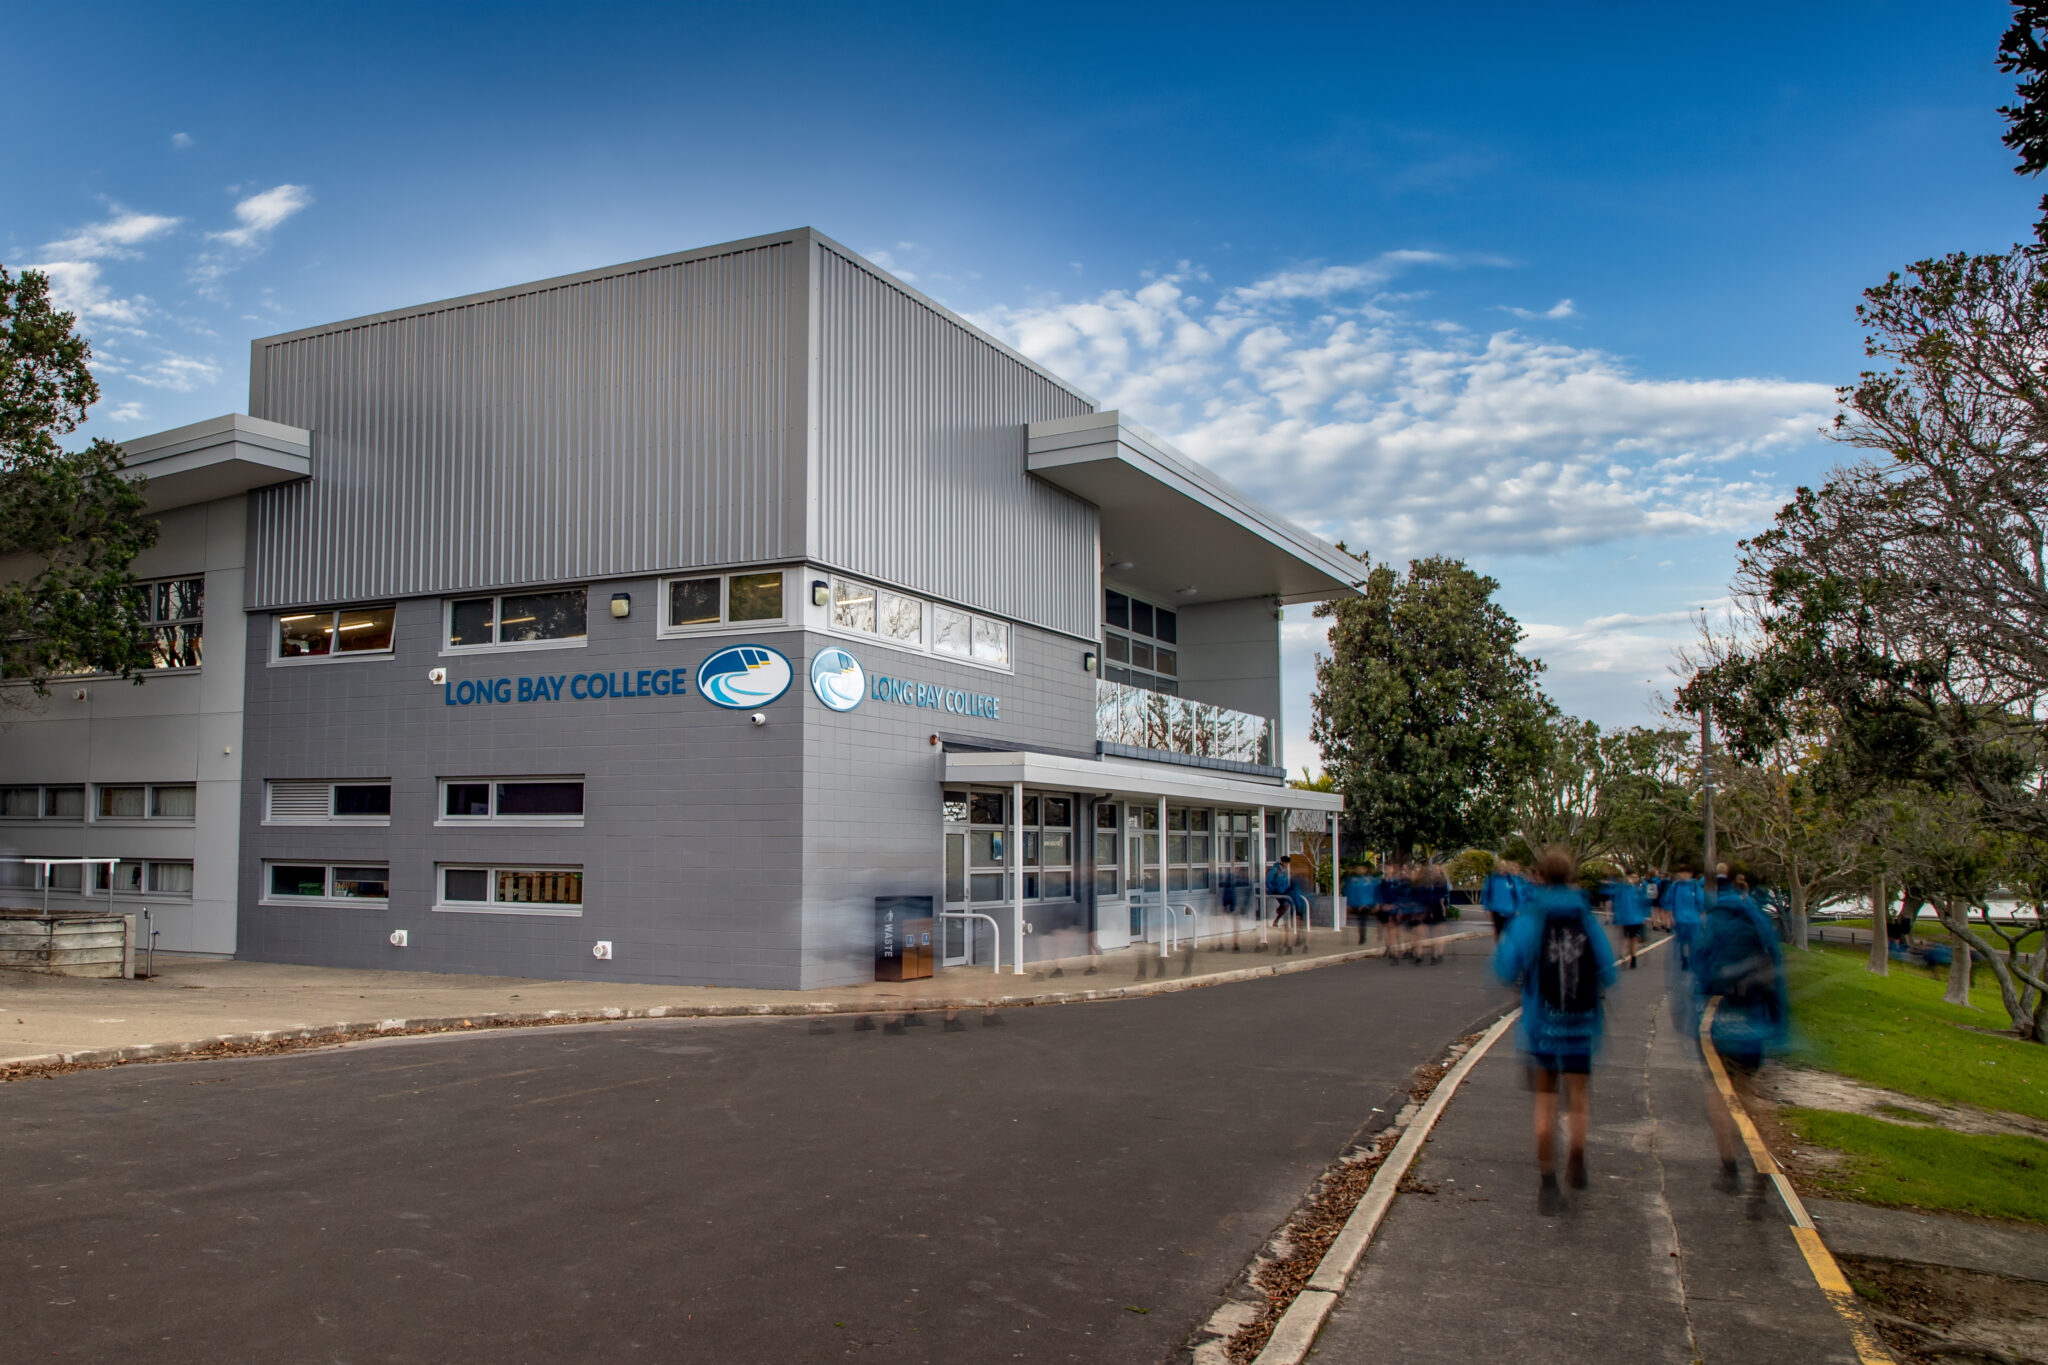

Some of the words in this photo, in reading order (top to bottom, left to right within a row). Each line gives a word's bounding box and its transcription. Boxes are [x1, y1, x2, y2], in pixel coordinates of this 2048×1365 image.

[445, 679, 512, 705] LONG
[517, 675, 566, 701] BAY
[570, 668, 687, 699] COLLEGE
[871, 674, 914, 705] LONG
[916, 682, 943, 710] BAY
[945, 688, 1000, 720] COLLEGE
[884, 923, 894, 957] WASTE
